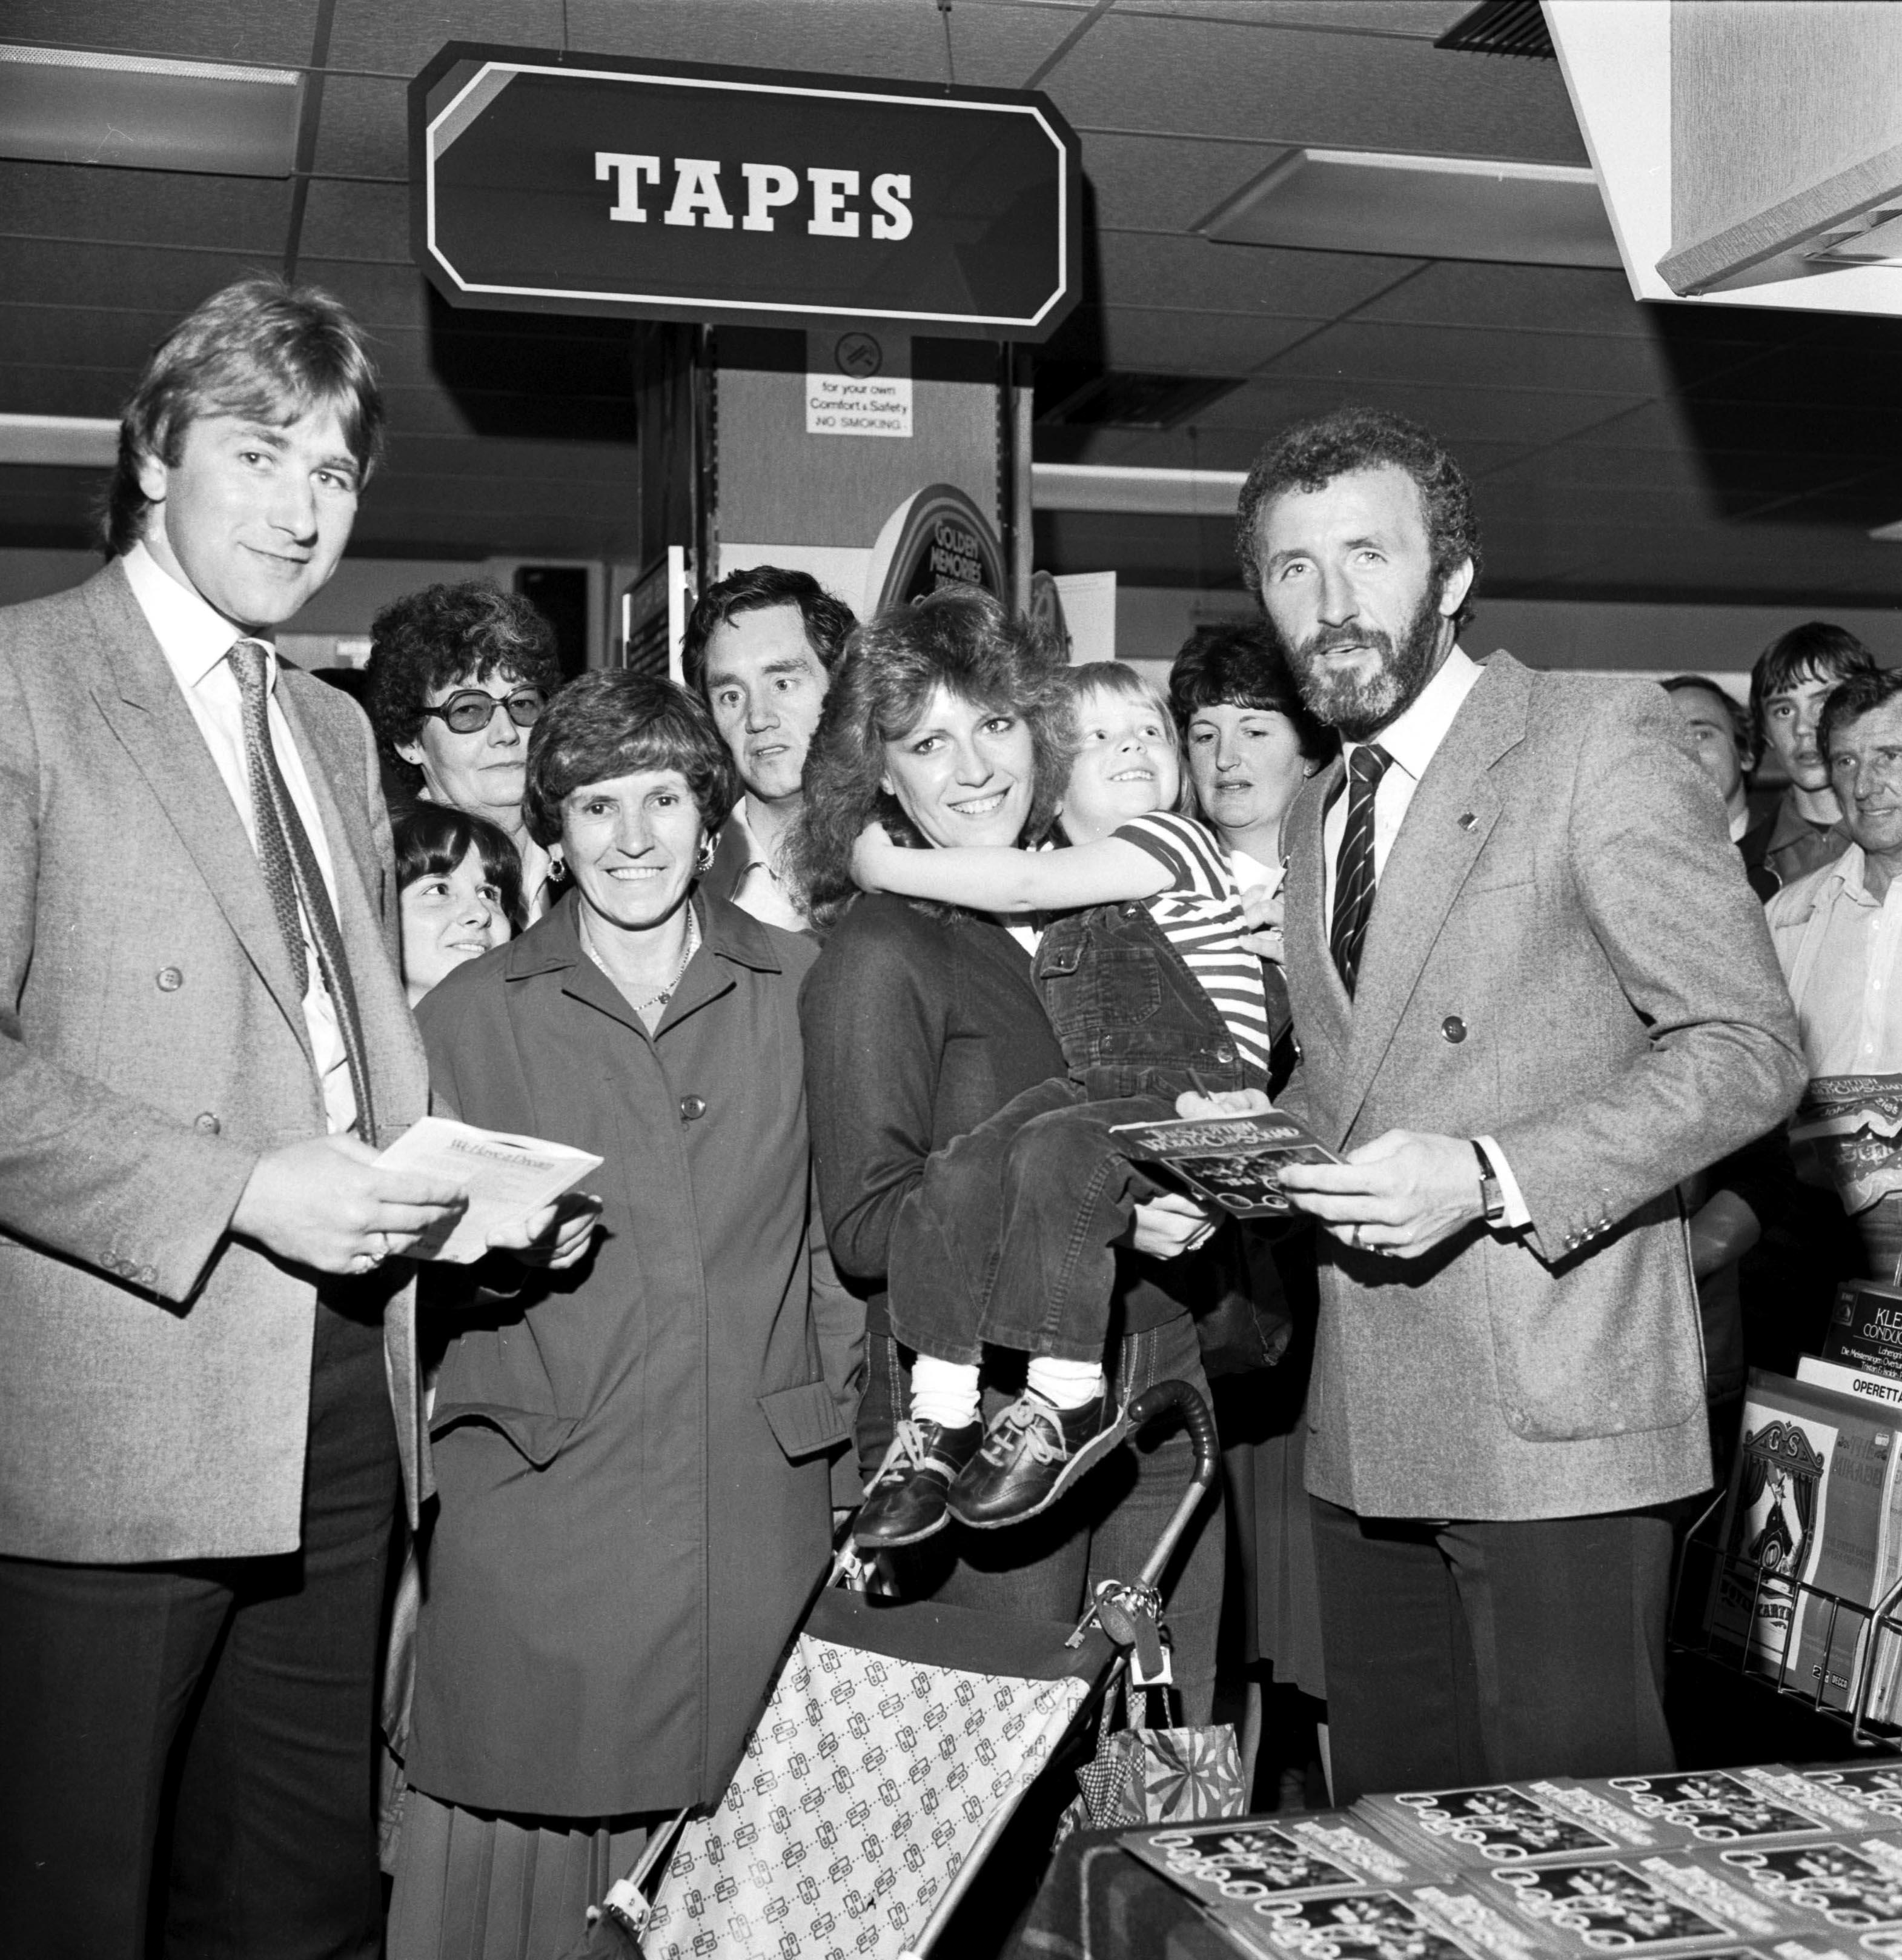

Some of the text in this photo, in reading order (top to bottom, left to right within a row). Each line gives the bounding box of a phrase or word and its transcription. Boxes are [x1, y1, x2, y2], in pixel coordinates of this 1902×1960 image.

[595, 151, 913, 241] TAPES
[822, 382, 896, 395] for your own
[810, 397, 860, 411] Comfort
[870, 400, 907, 414] Safety
[815, 416, 901, 430] NO SMOKING
[935, 520, 979, 559] GOLDEN
[929, 546, 982, 585] MEMORIES
[1786, 1434, 1801, 1457] S
